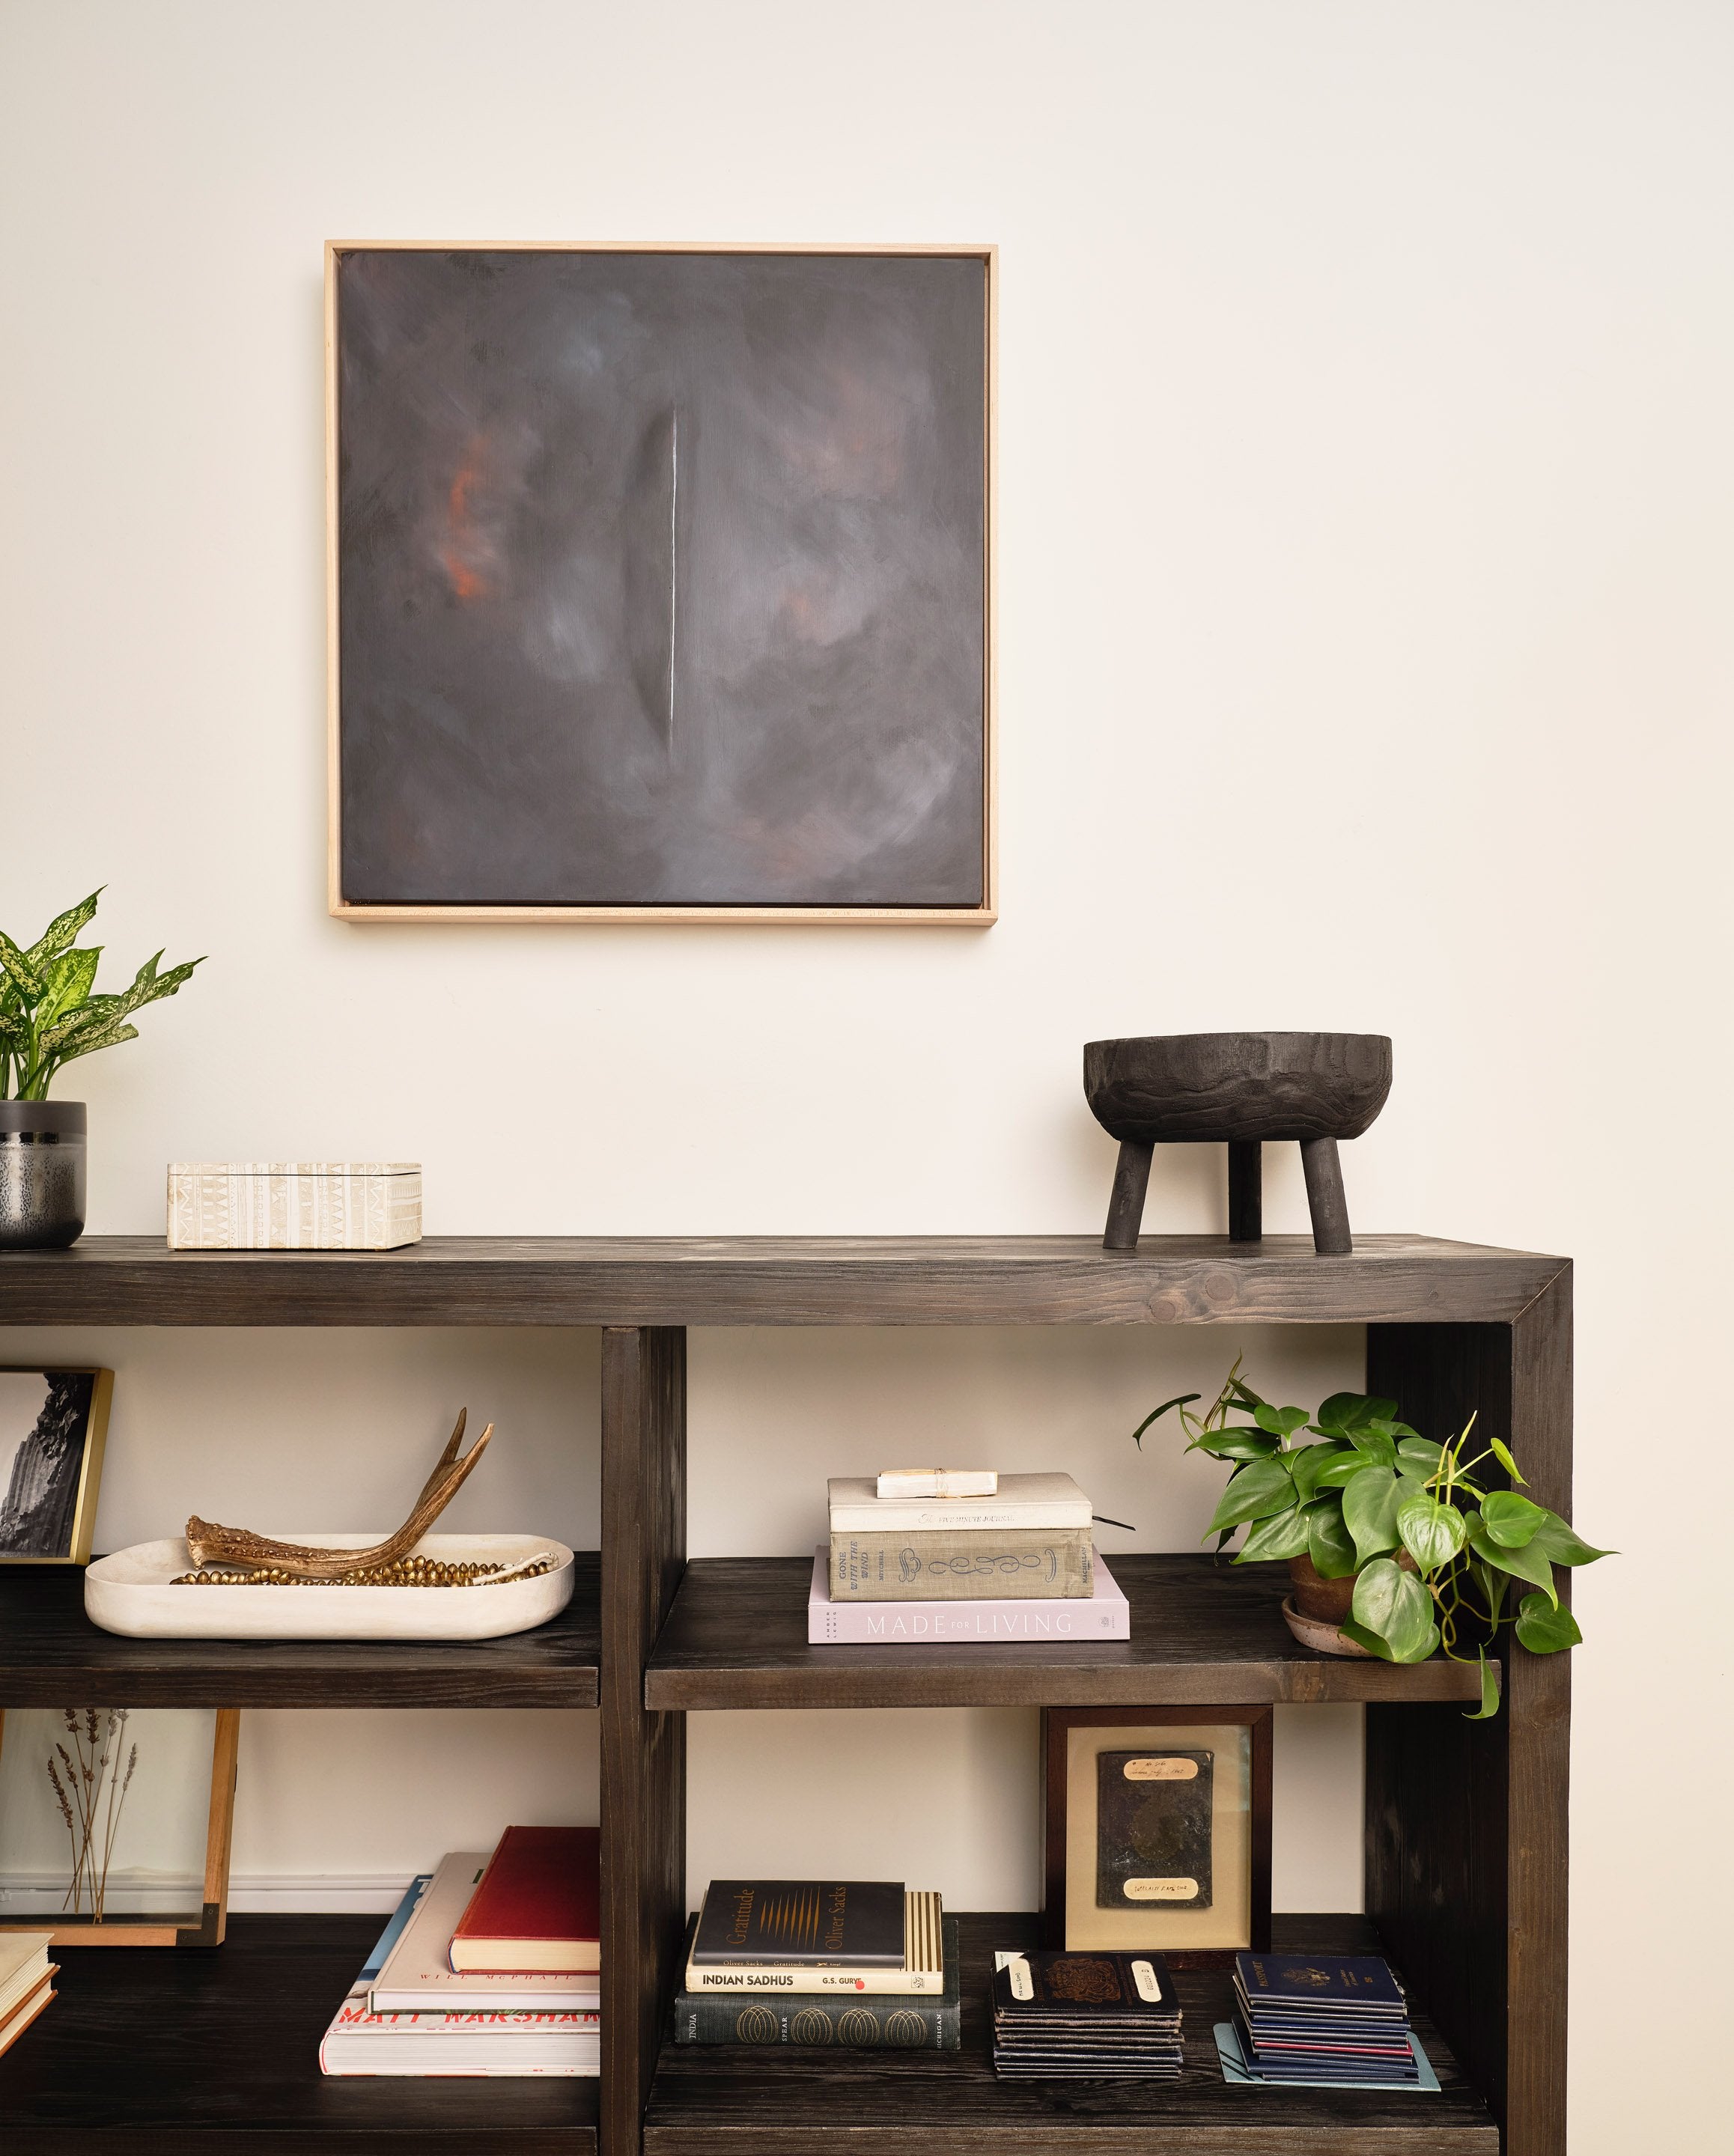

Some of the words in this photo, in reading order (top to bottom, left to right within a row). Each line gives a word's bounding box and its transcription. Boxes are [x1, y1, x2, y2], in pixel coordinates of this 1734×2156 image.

[867, 1616, 946, 1634] MADE
[976, 1613, 1071, 1633] LIVING
[828, 1886, 847, 1914] Sacks
[725, 1888, 755, 1944] Gratitude
[824, 1916, 845, 1949] Oliver
[702, 1974, 743, 1985] INDIAN
[747, 1975, 794, 1985] SADHUS
[1252, 1961, 1268, 1987] PASSPORT
[338, 2007, 421, 2023] MATT
[689, 2013, 697, 2039] INDIA
